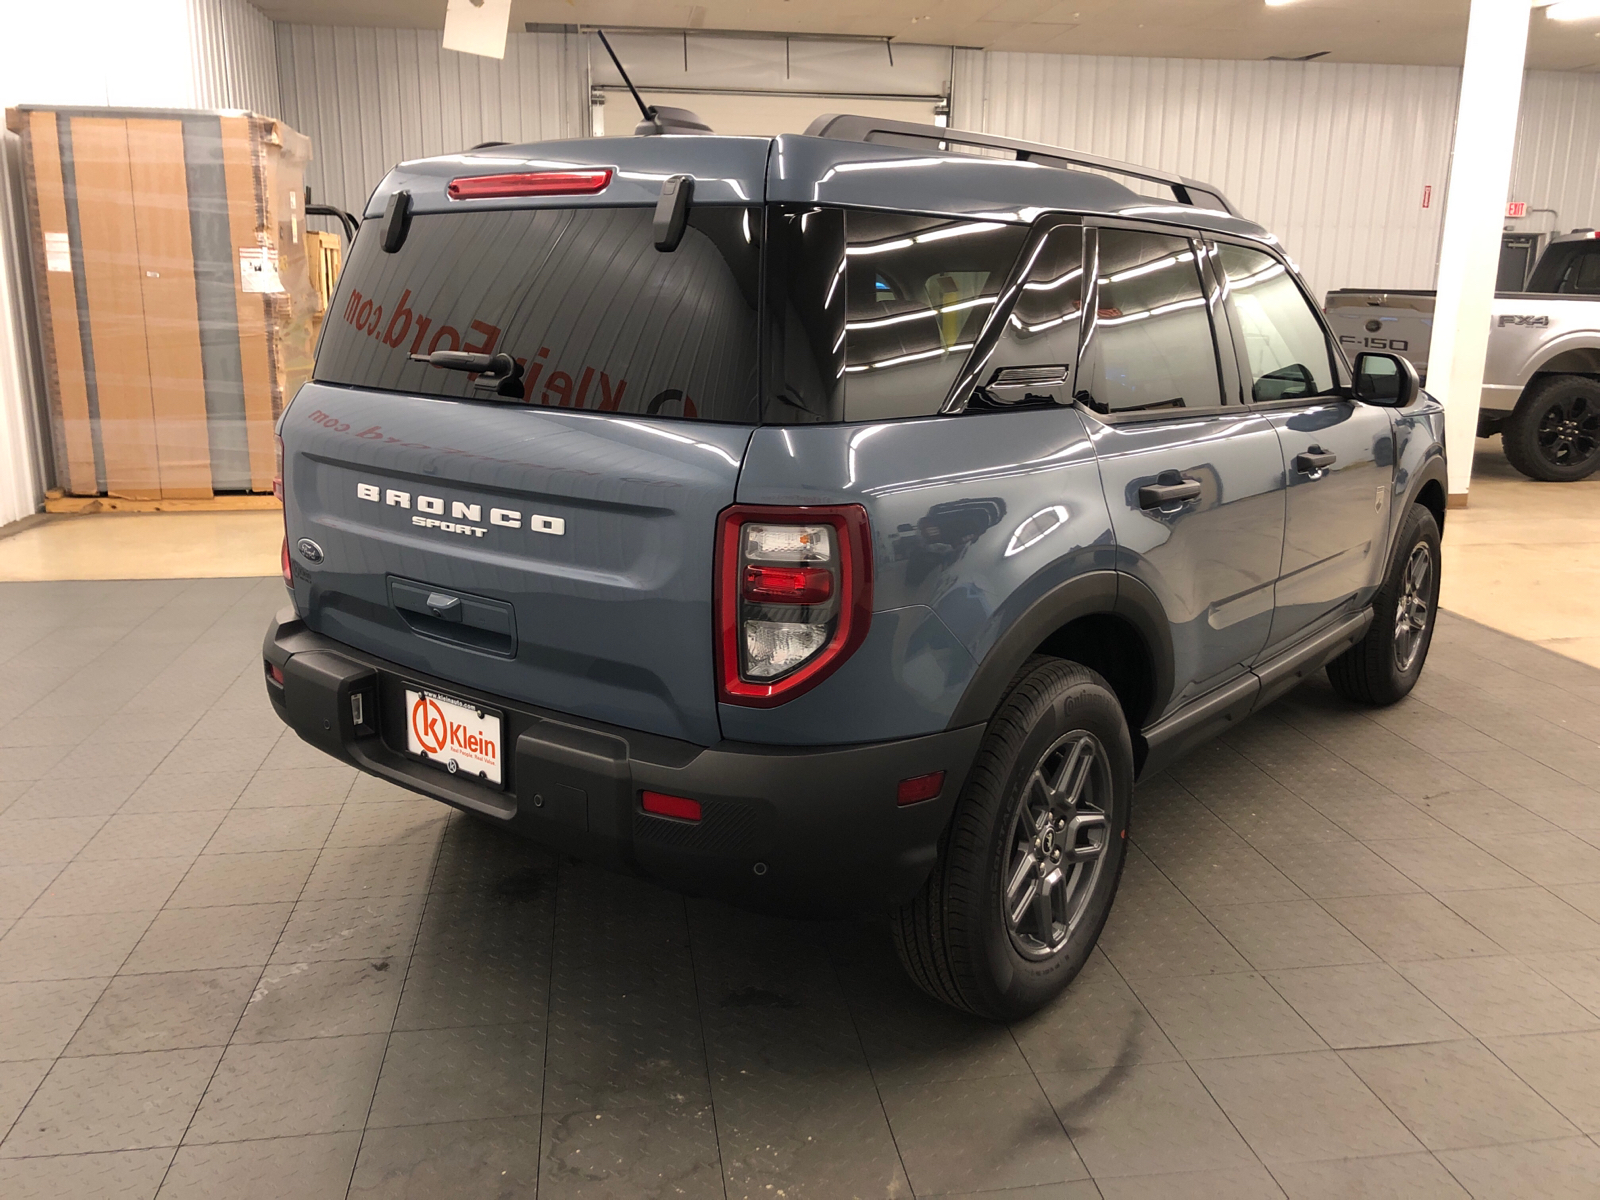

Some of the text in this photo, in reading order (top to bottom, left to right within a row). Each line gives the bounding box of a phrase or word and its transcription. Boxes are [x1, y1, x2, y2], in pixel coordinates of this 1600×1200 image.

[1508, 203, 1524, 216] EXIT
[1497, 315, 1549, 328] FX4
[1339, 335, 1409, 352] F-150
[357, 483, 566, 536] BRONCO
[412, 516, 488, 537] SPORT
[424, 691, 476, 710] www.kleinauto.com
[450, 721, 496, 759] Klein
[459, 749, 473, 759] People.
[474, 754, 483, 762] Real
[484, 757, 496, 766] Value.
